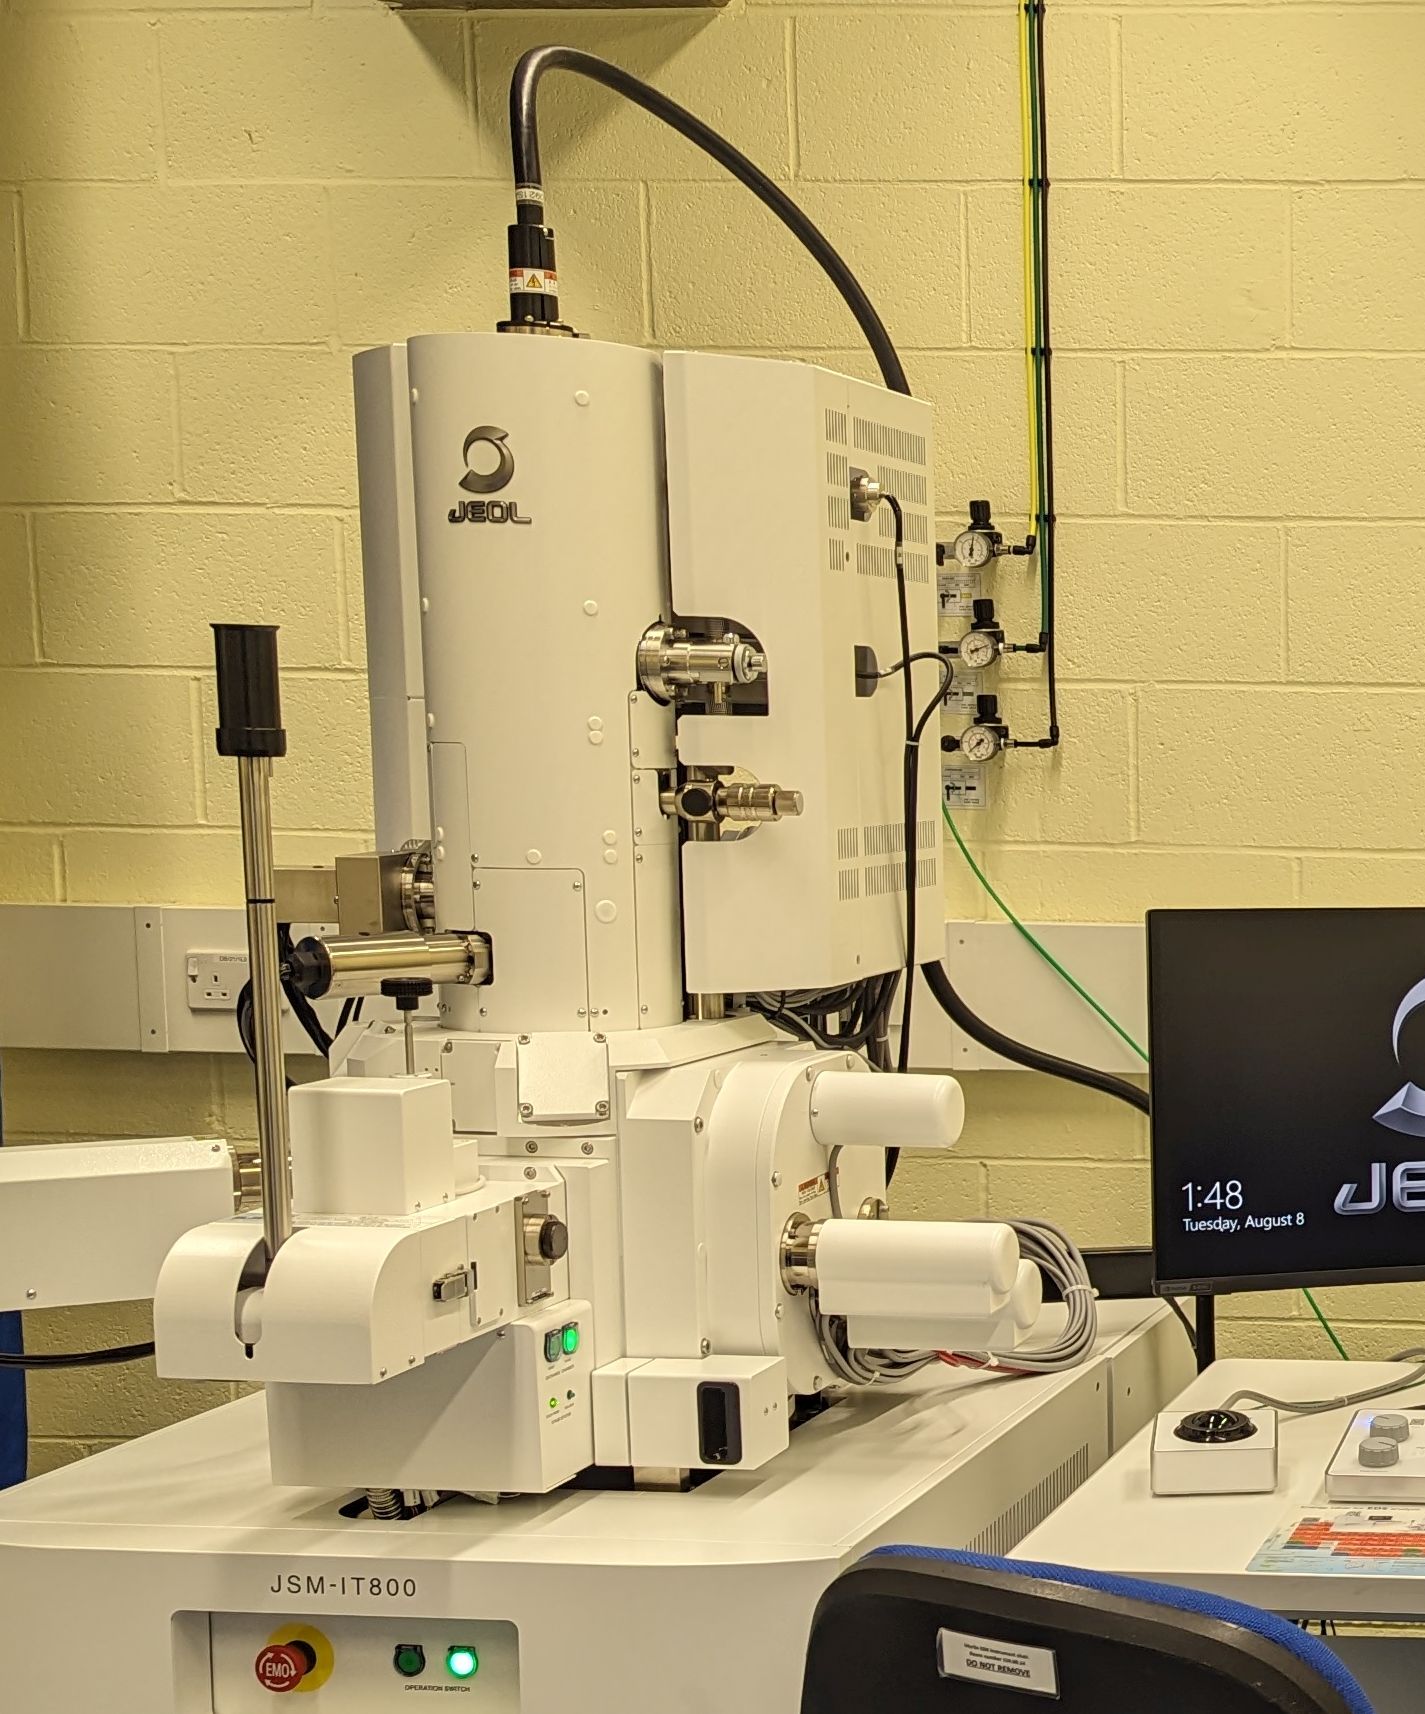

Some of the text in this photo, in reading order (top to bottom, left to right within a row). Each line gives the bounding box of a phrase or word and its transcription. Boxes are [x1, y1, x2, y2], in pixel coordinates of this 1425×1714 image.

[448, 501, 532, 524] JEOL
[1181, 1180, 1243, 1211] 1:48
[1182, 1212, 1305, 1232] Tuesday, August 8
[270, 1574, 417, 1597] JSM-IT800
[265, 1662, 290, 1679] EMO
[966, 1658, 978, 1668] DO
[979, 1661, 996, 1672] NOT
[997, 1664, 1031, 1678] REMOVE
[404, 1684, 471, 1693] OPERATION SWITCH
